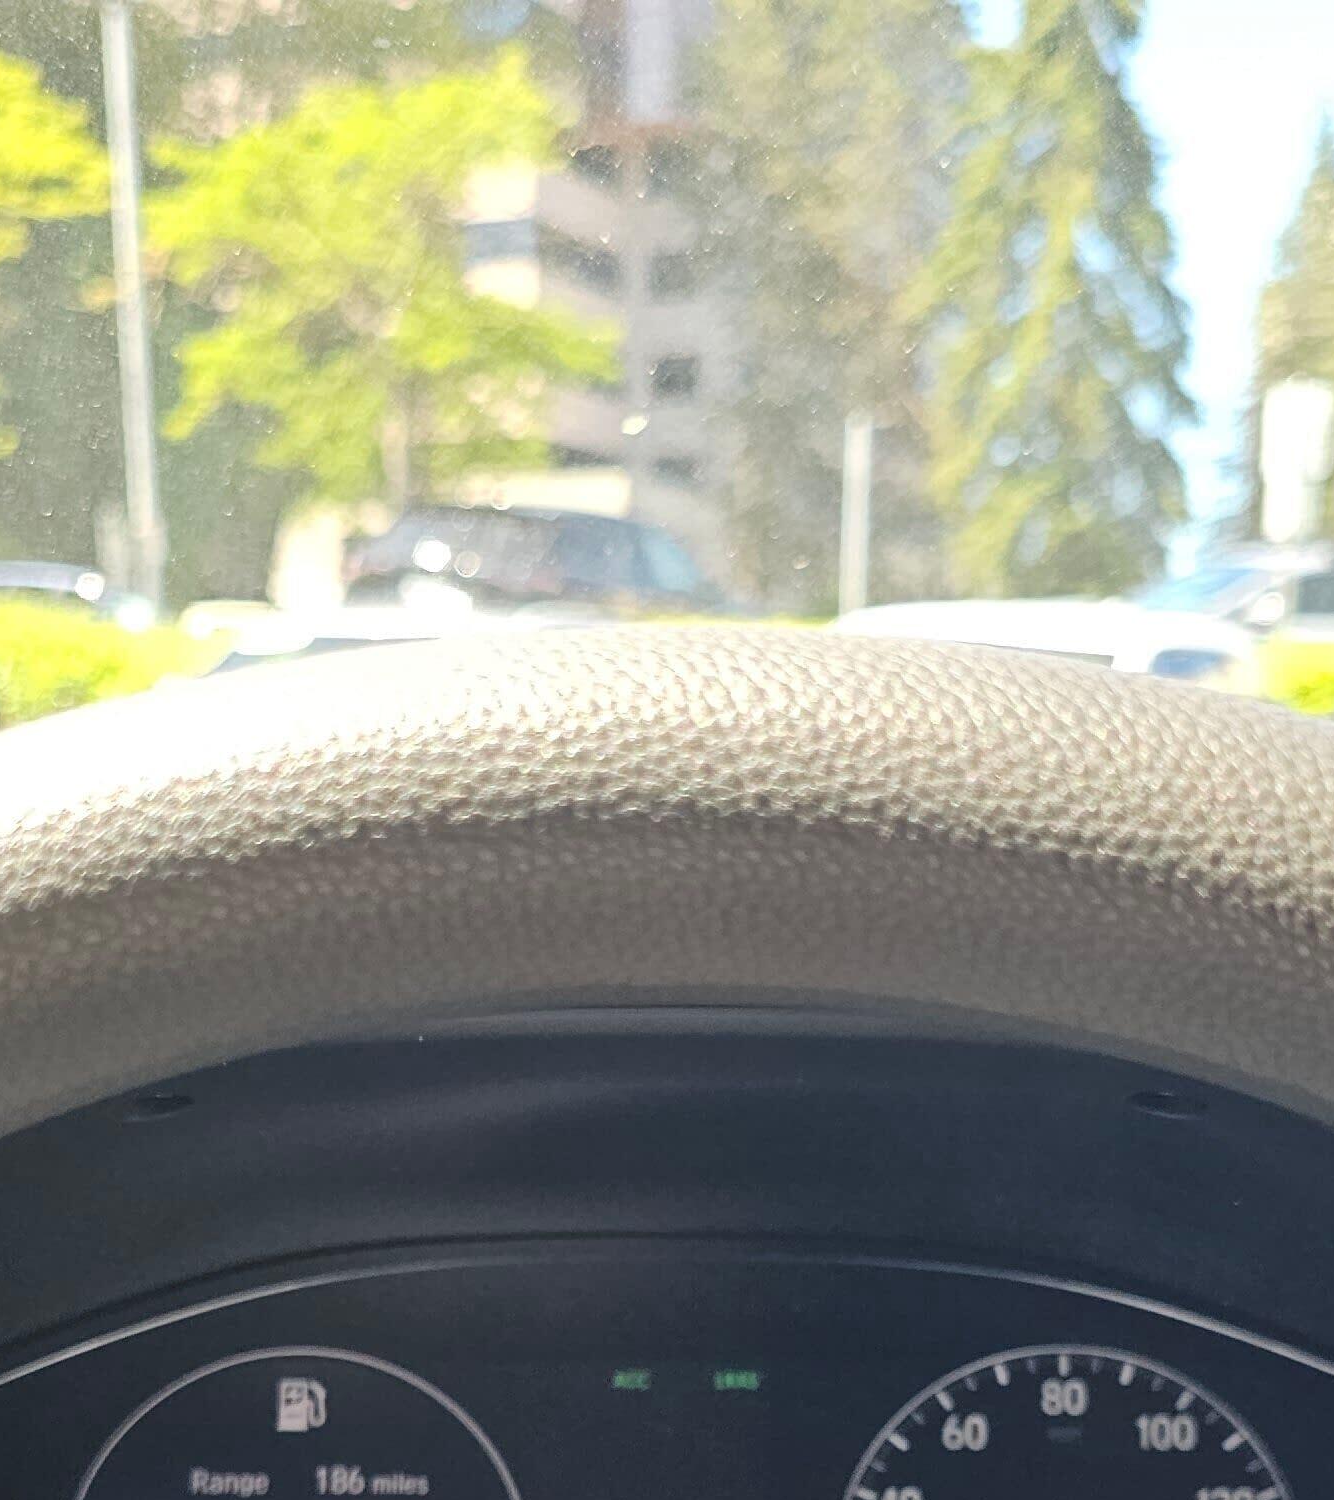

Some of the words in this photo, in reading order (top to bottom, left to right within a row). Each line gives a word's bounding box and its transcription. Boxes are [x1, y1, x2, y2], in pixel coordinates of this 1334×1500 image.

[1041, 1379, 1088, 1415] 80
[942, 1414, 987, 1451] 60
[1136, 1414, 1198, 1451] 100
[191, 1468, 269, 1497] Range
[316, 1467, 364, 1494] 186
[372, 1472, 429, 1495] miles
